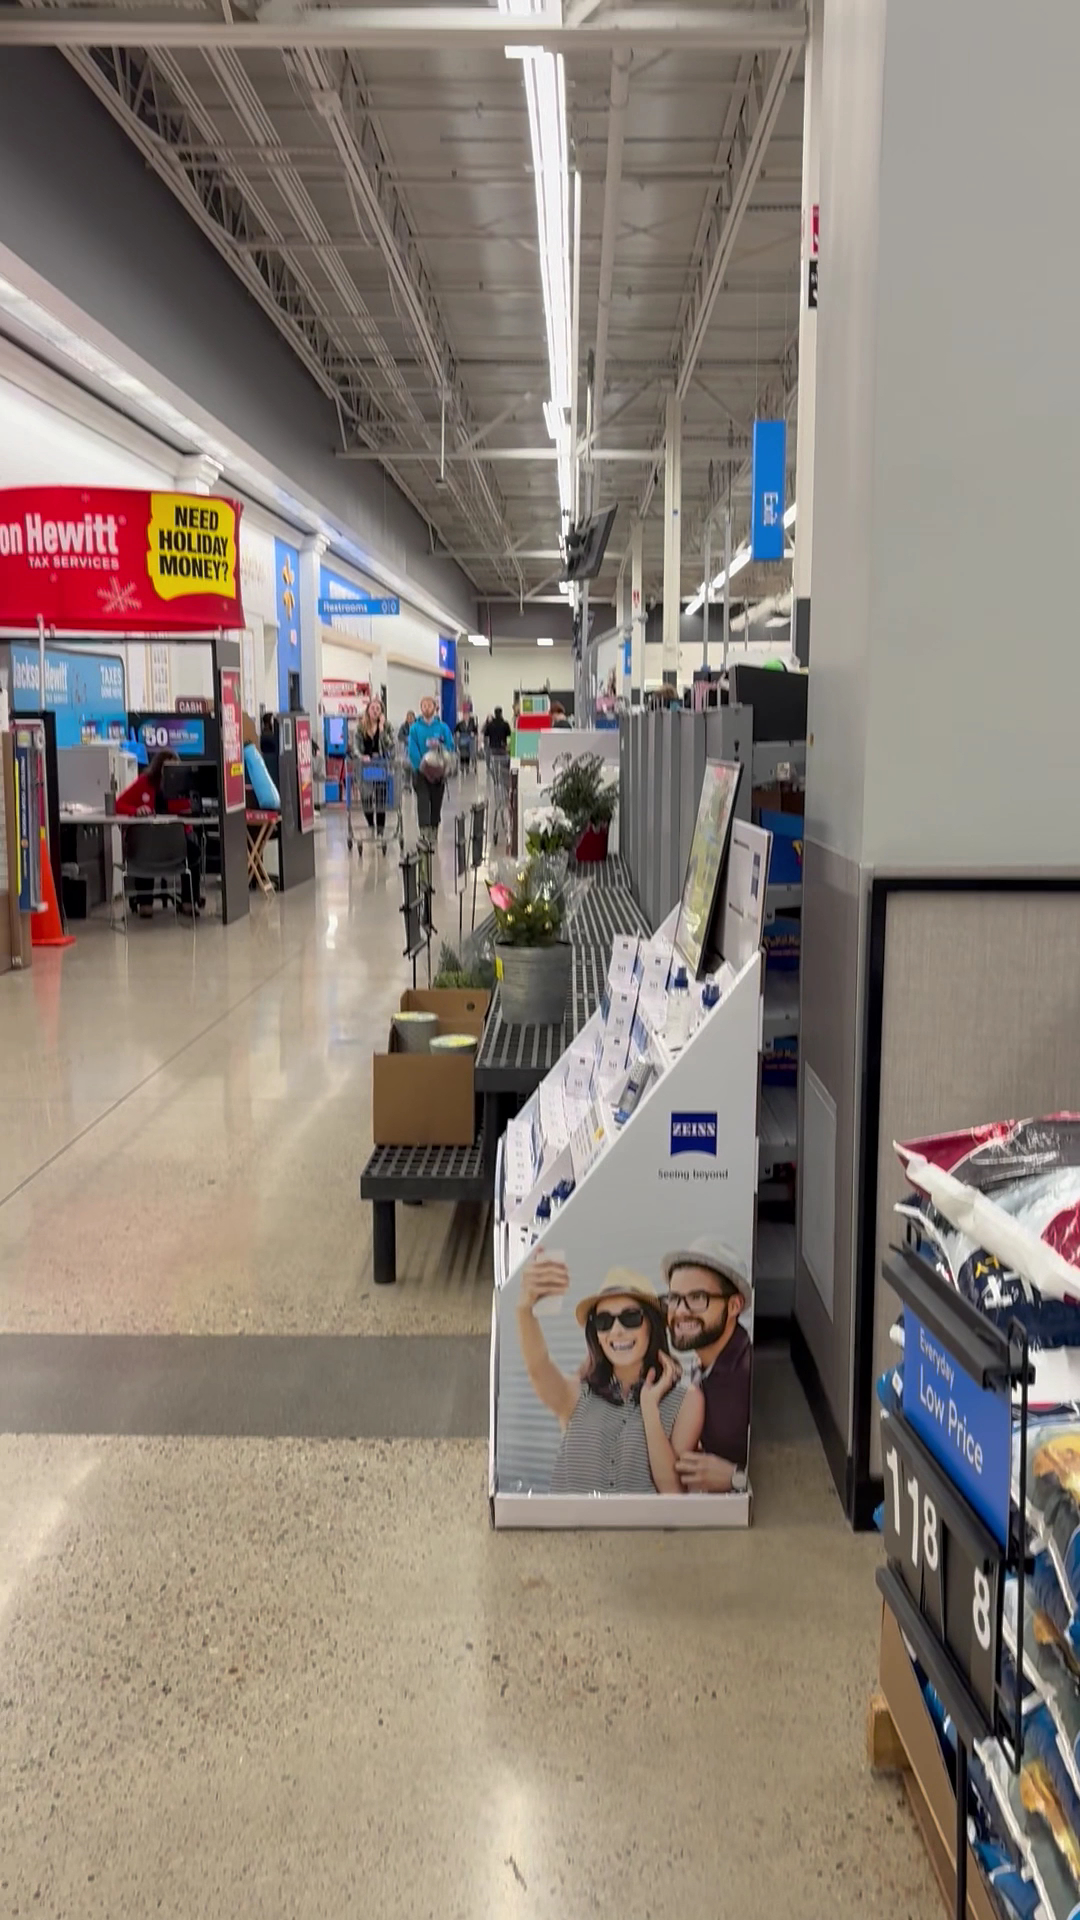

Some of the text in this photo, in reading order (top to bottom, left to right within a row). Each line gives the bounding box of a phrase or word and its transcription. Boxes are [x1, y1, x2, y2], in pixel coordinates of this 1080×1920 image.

[174, 506, 219, 531] NEED
[25, 512, 119, 554] Hewitt
[158, 528, 228, 557] HOLIDAY
[28, 555, 119, 571] TAX SERVICES
[159, 555, 229, 582] MONEY?
[323, 602, 368, 613] Restrooms
[13, 655, 41, 690] Jackso
[672, 1121, 716, 1137] ZEISS
[658, 1168, 728, 1181] Seeing beyond
[919, 1326, 954, 1389] Everyday
[919, 1364, 984, 1475] Low Price
